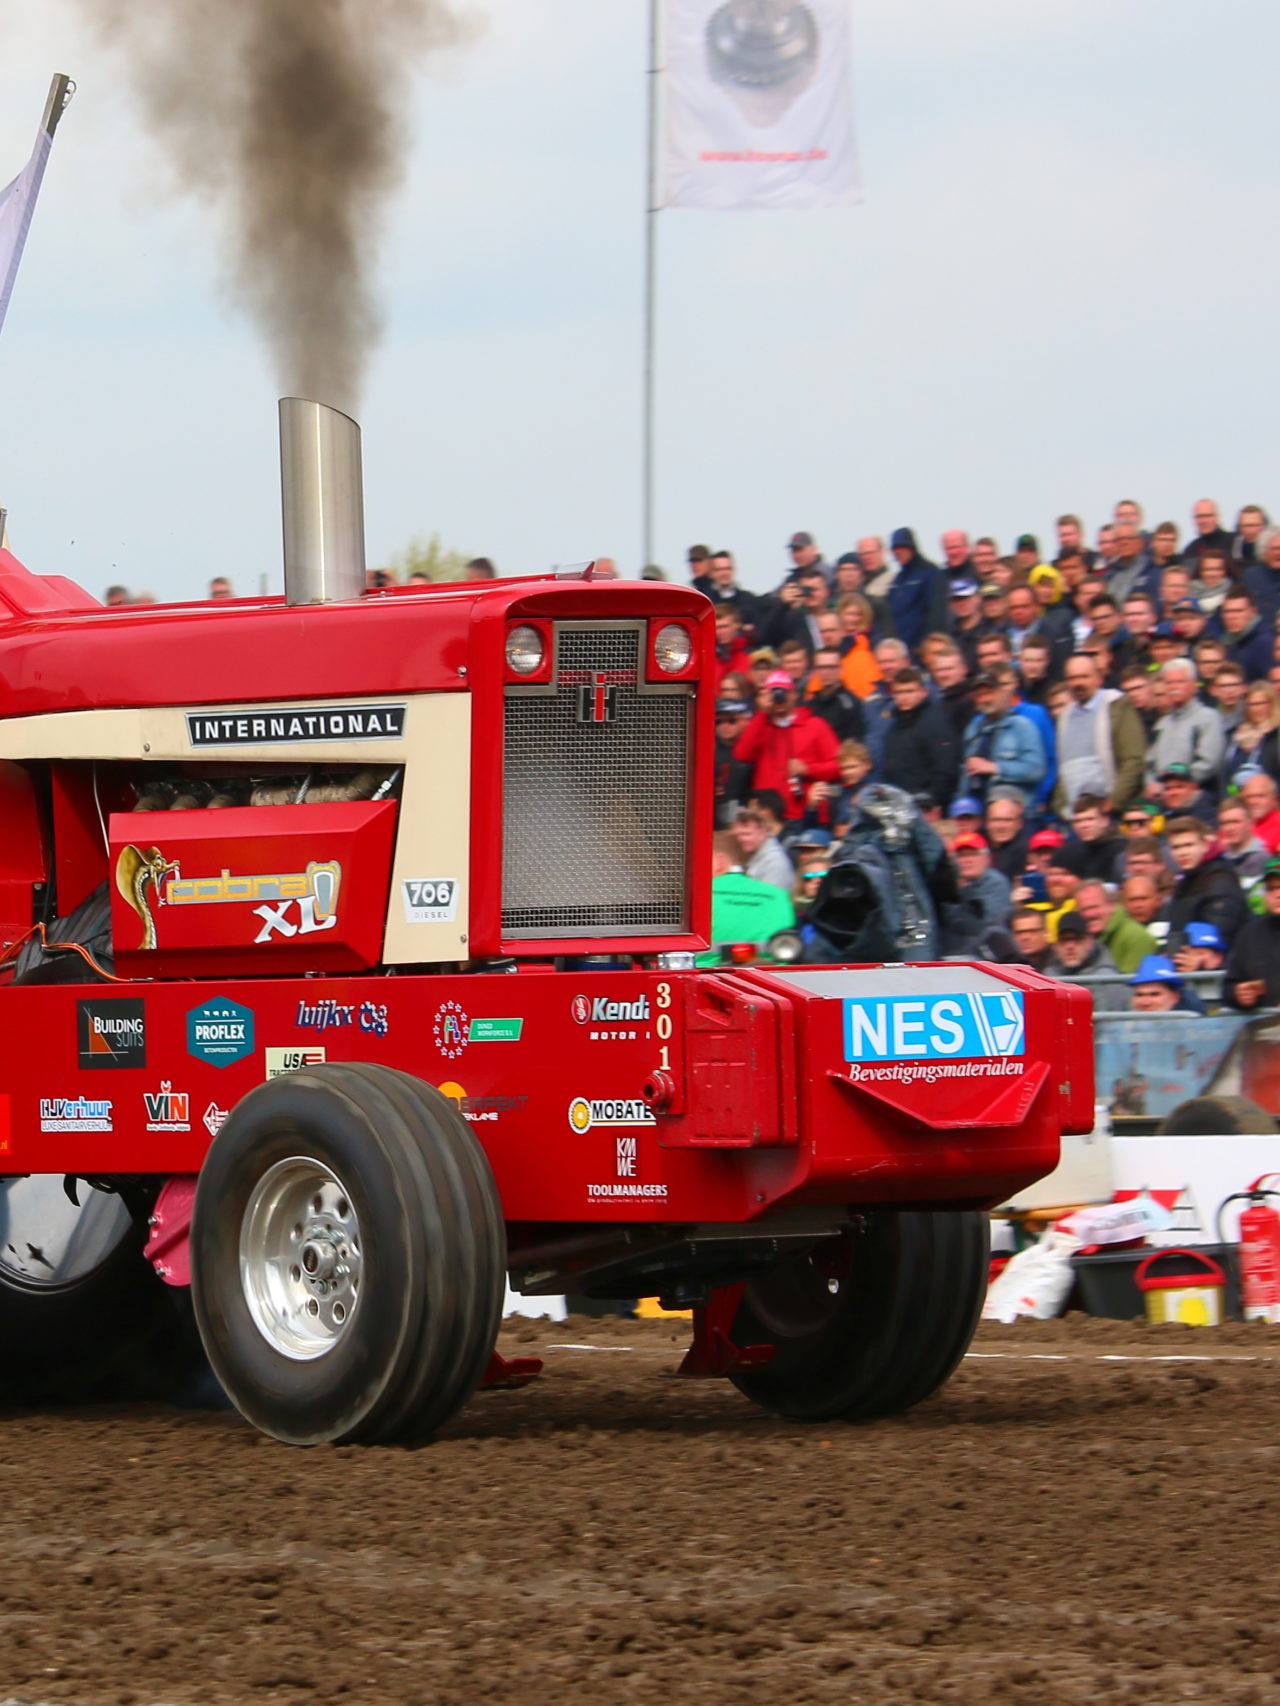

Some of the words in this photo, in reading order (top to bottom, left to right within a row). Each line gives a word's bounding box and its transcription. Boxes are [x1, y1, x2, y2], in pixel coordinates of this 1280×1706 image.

[195, 713, 399, 740] INTERNATIONAL
[168, 871, 307, 901] cobra
[410, 883, 450, 905] 706
[253, 896, 337, 943] XL
[414, 911, 448, 919] DIESEL
[93, 1016, 144, 1034] BUILDING
[195, 1024, 245, 1040] PROFLEX
[656, 982, 672, 1070] 301
[851, 1000, 965, 1057] NES
[116, 1031, 144, 1047] SUITS
[590, 1031, 636, 1040] MOTOR
[283, 1053, 307, 1068] USA
[849, 1057, 1024, 1084] Bevestigingsmaterialen
[587, 1184, 668, 1196] TOOLMANAGERS
